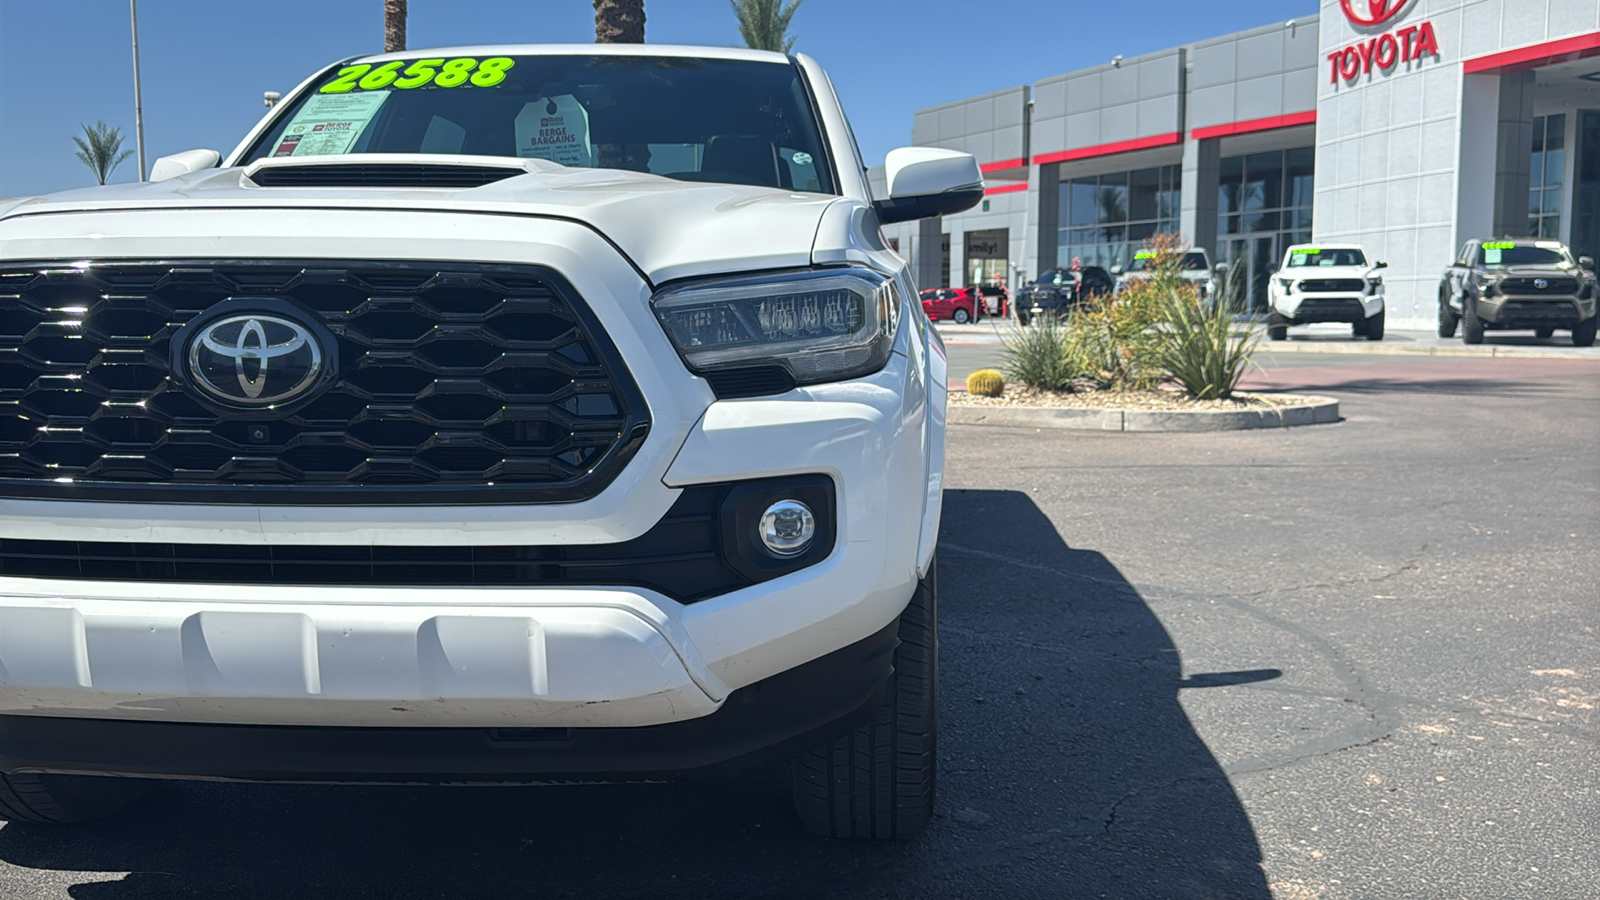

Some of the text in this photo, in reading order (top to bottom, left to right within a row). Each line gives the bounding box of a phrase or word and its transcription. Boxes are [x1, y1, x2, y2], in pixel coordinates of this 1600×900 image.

[1327, 21, 1438, 84] TOYOTA
[319, 57, 515, 93] 26588
[531, 134, 576, 145] BARGAINS
[539, 127, 567, 137] BERGE
